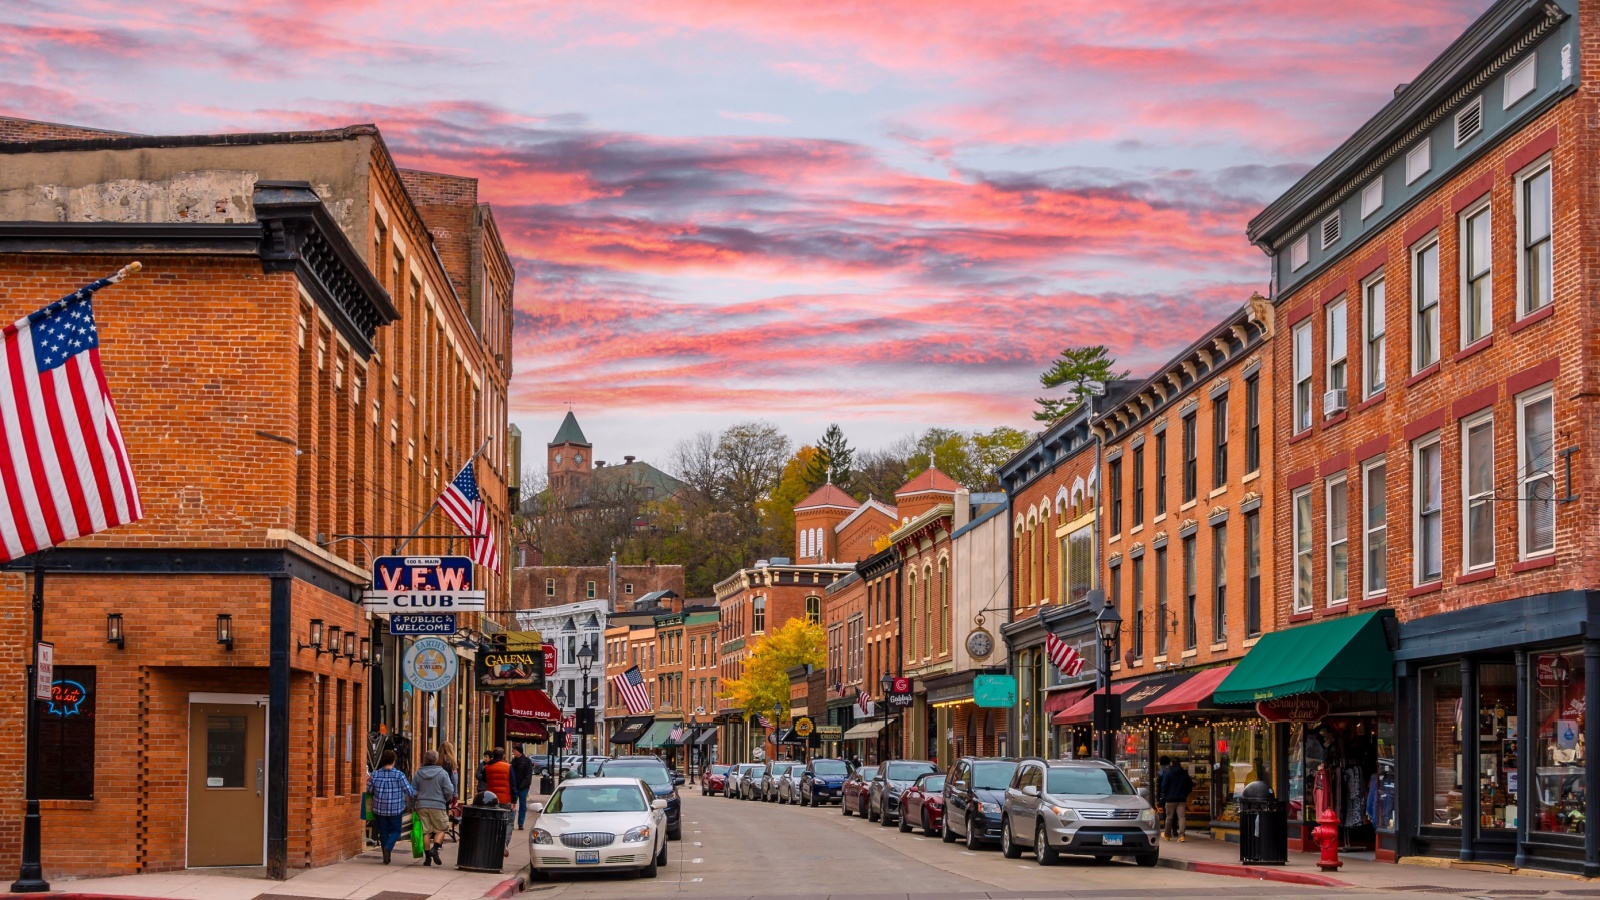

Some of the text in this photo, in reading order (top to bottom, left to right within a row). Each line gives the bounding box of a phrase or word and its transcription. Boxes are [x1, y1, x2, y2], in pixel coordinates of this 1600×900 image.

[393, 594, 453, 607] CLUB
[415, 640, 447, 651] EARTH'S
[484, 654, 534, 667] GALENA
[410, 673, 451, 689] TREASURES
[890, 694, 913, 705] Gabby's
[1268, 695, 1319, 713] Strawberry
[1289, 706, 1314, 718] Lane
